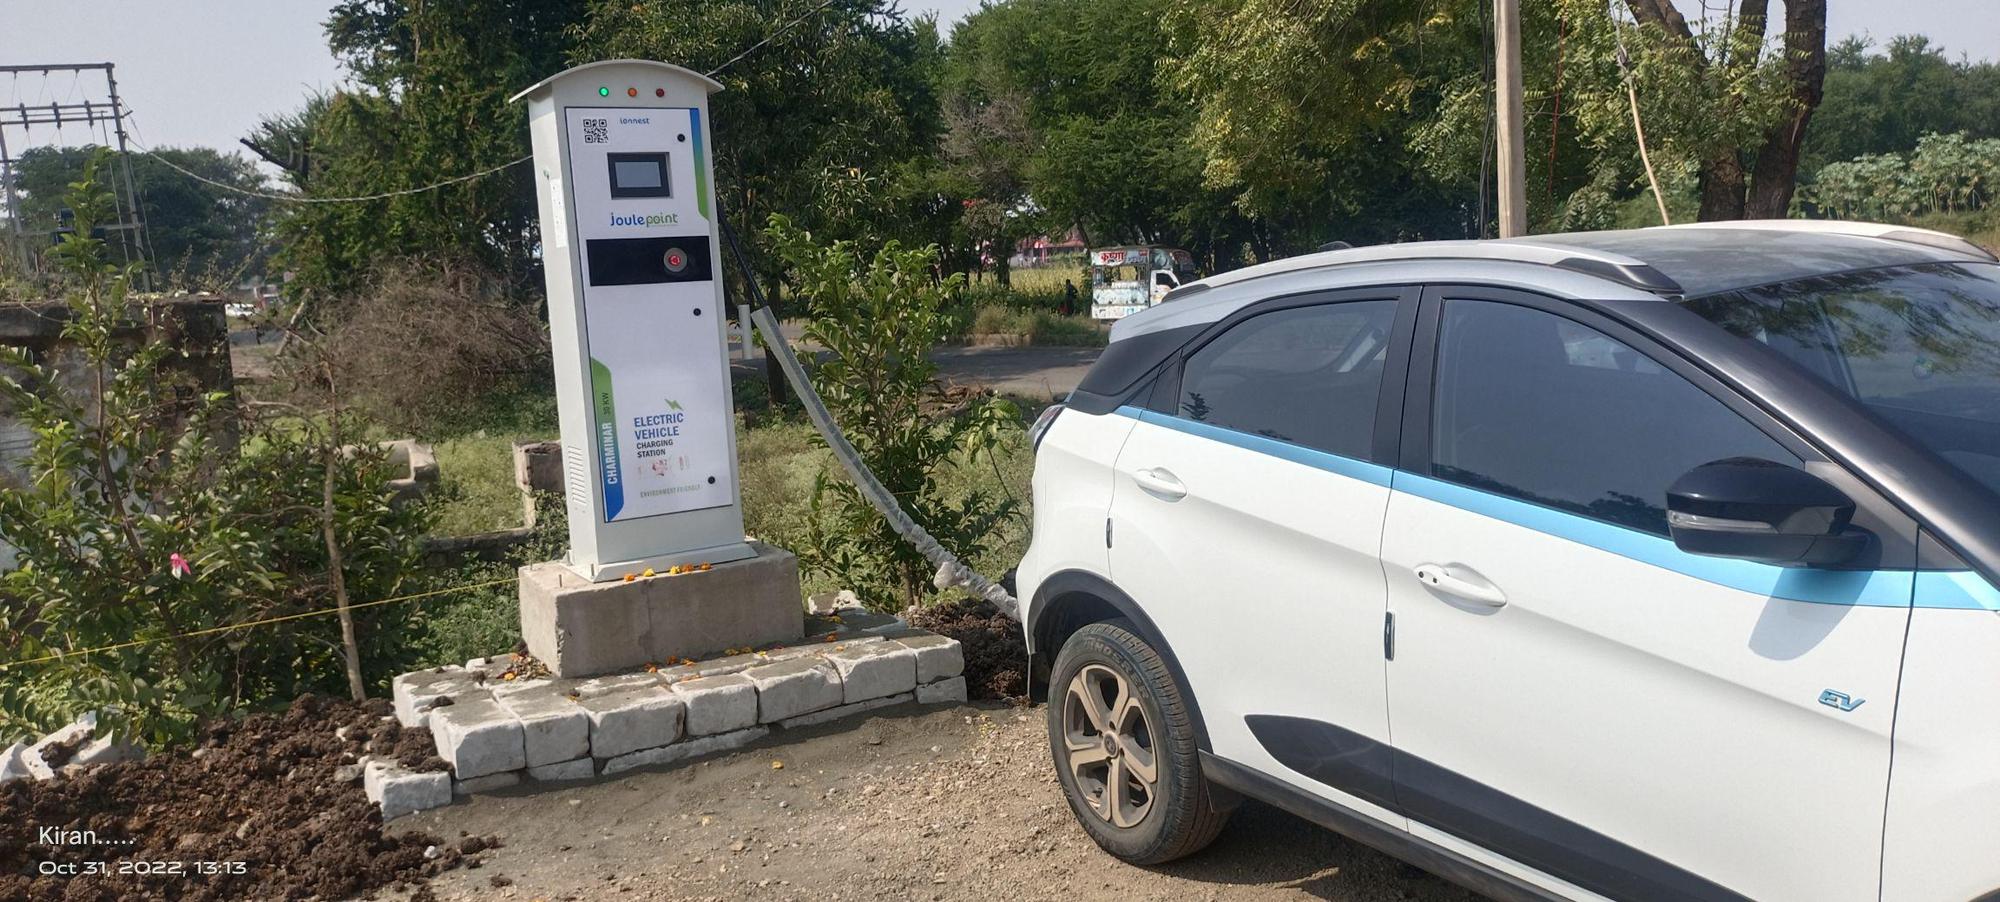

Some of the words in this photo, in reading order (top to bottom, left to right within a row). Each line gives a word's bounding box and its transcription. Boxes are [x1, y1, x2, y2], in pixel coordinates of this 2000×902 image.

[620, 117, 650, 125] ionnest
[634, 412, 684, 427] ELECTRIC
[634, 425, 680, 440] VEHICLE
[636, 439, 674, 450] CHARGING
[602, 422, 618, 485] CHARMINAR
[637, 448, 666, 458] STATION
[640, 487, 676, 498] ENVIRONMENT
[1818, 688, 1866, 712] EV
